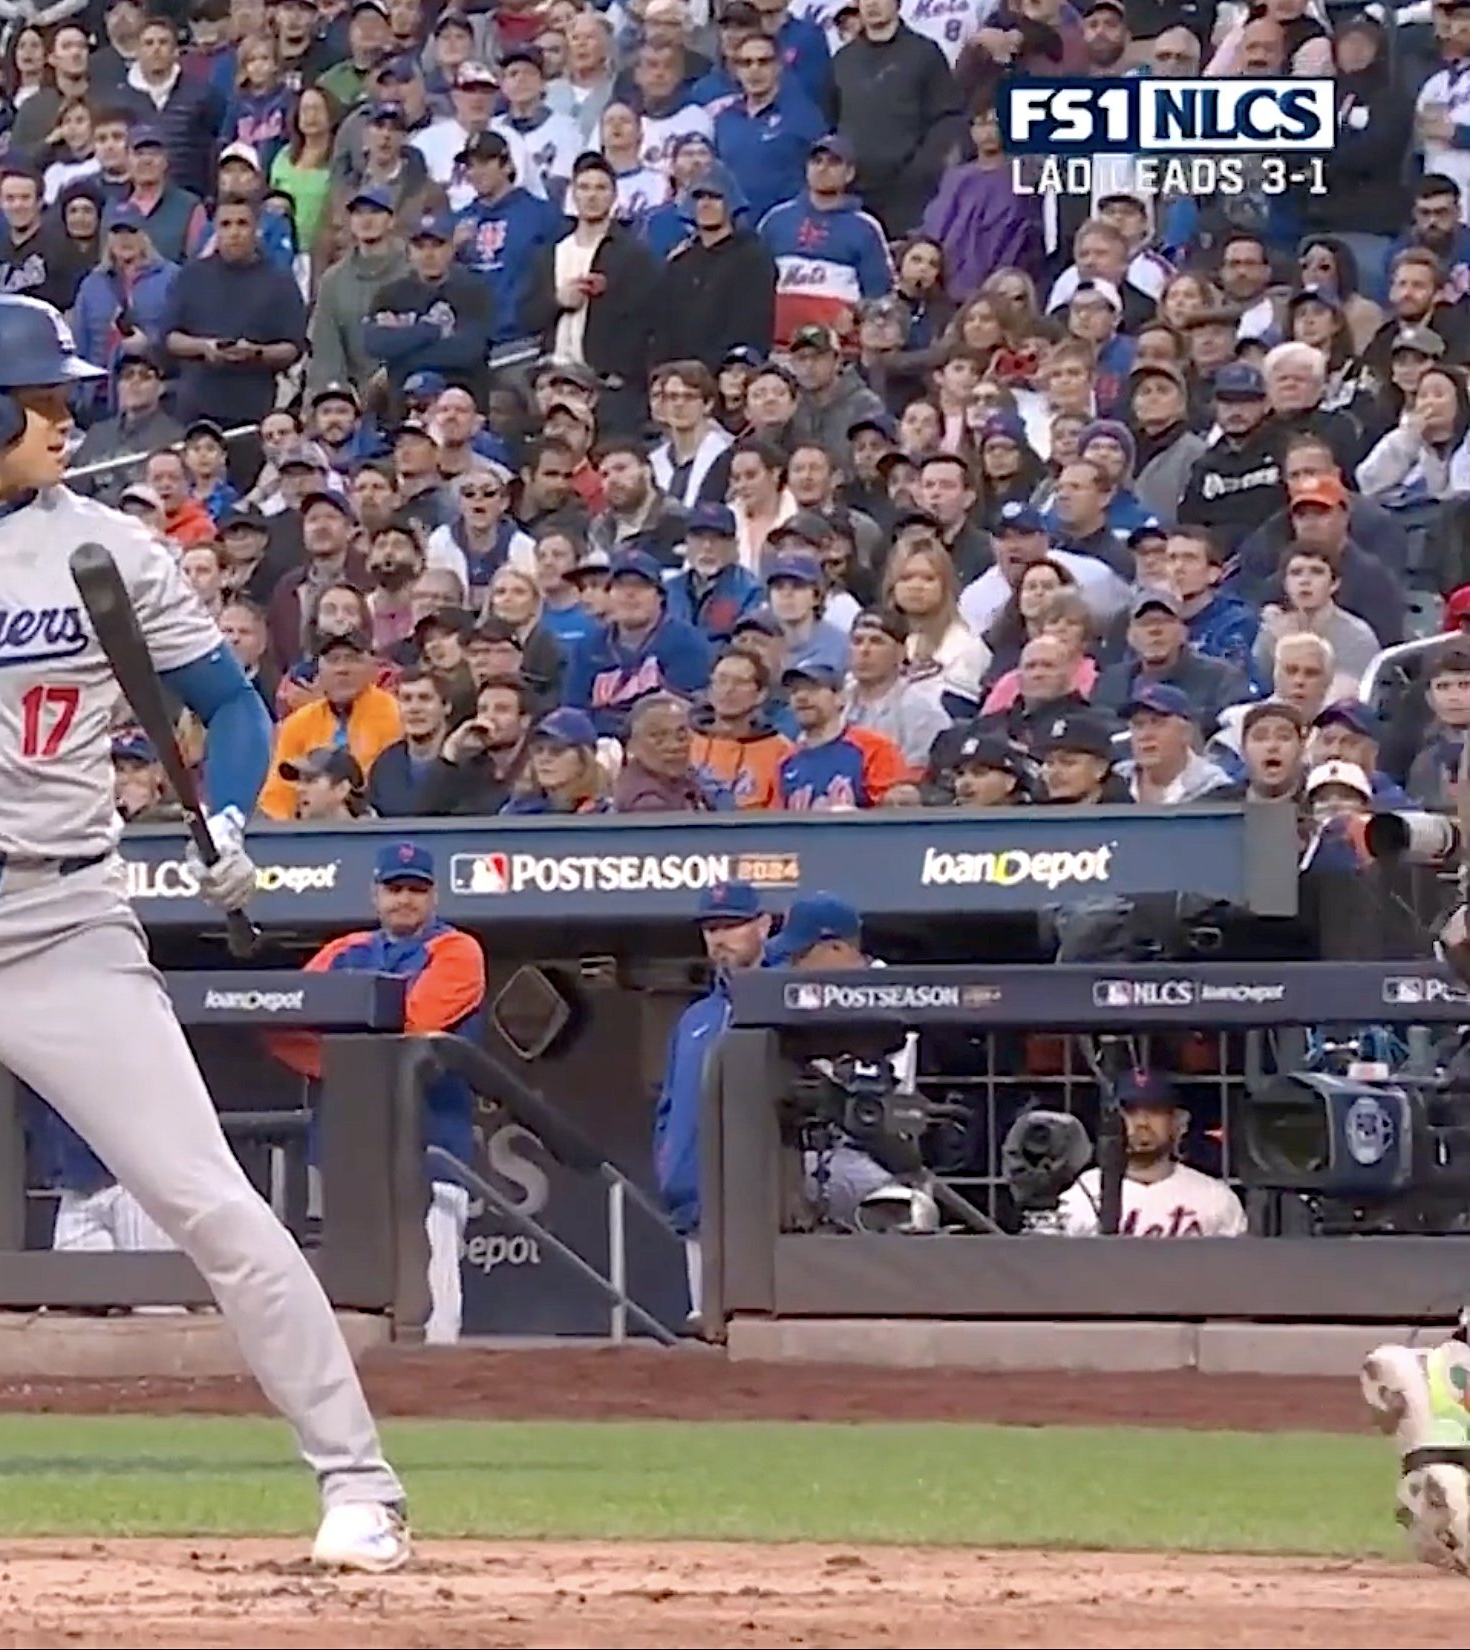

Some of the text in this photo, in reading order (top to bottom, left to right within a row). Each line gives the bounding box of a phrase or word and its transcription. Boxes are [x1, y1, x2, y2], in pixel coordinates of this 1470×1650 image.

[20, 684, 81, 761] 17
[255, 863, 337, 894] Depot
[512, 854, 730, 892] POSTSEASON
[921, 845, 1113, 891] loanDepot
[823, 984, 960, 1009] POSTSEASON
[1133, 981, 1192, 1005] NLCS
